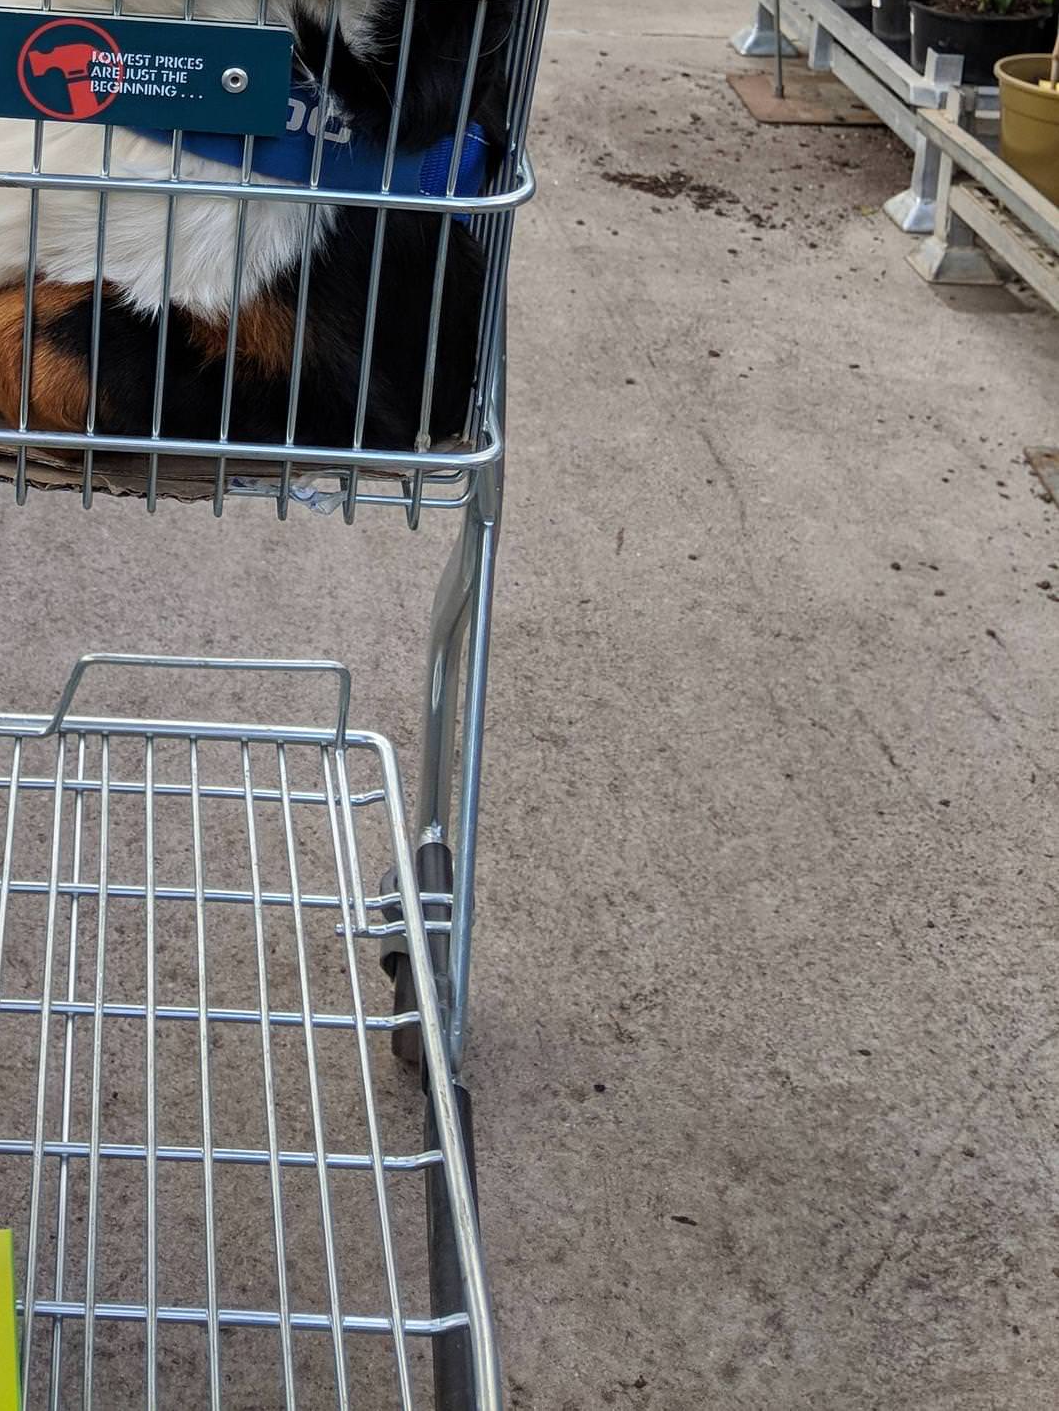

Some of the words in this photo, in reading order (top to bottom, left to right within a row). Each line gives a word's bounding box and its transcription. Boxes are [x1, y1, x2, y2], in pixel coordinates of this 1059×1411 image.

[91, 50, 151, 66] LOWEST
[155, 55, 204, 70] PRICES
[90, 65, 120, 79] ARE
[122, 68, 158, 81] JUST
[161, 70, 188, 84] THE
